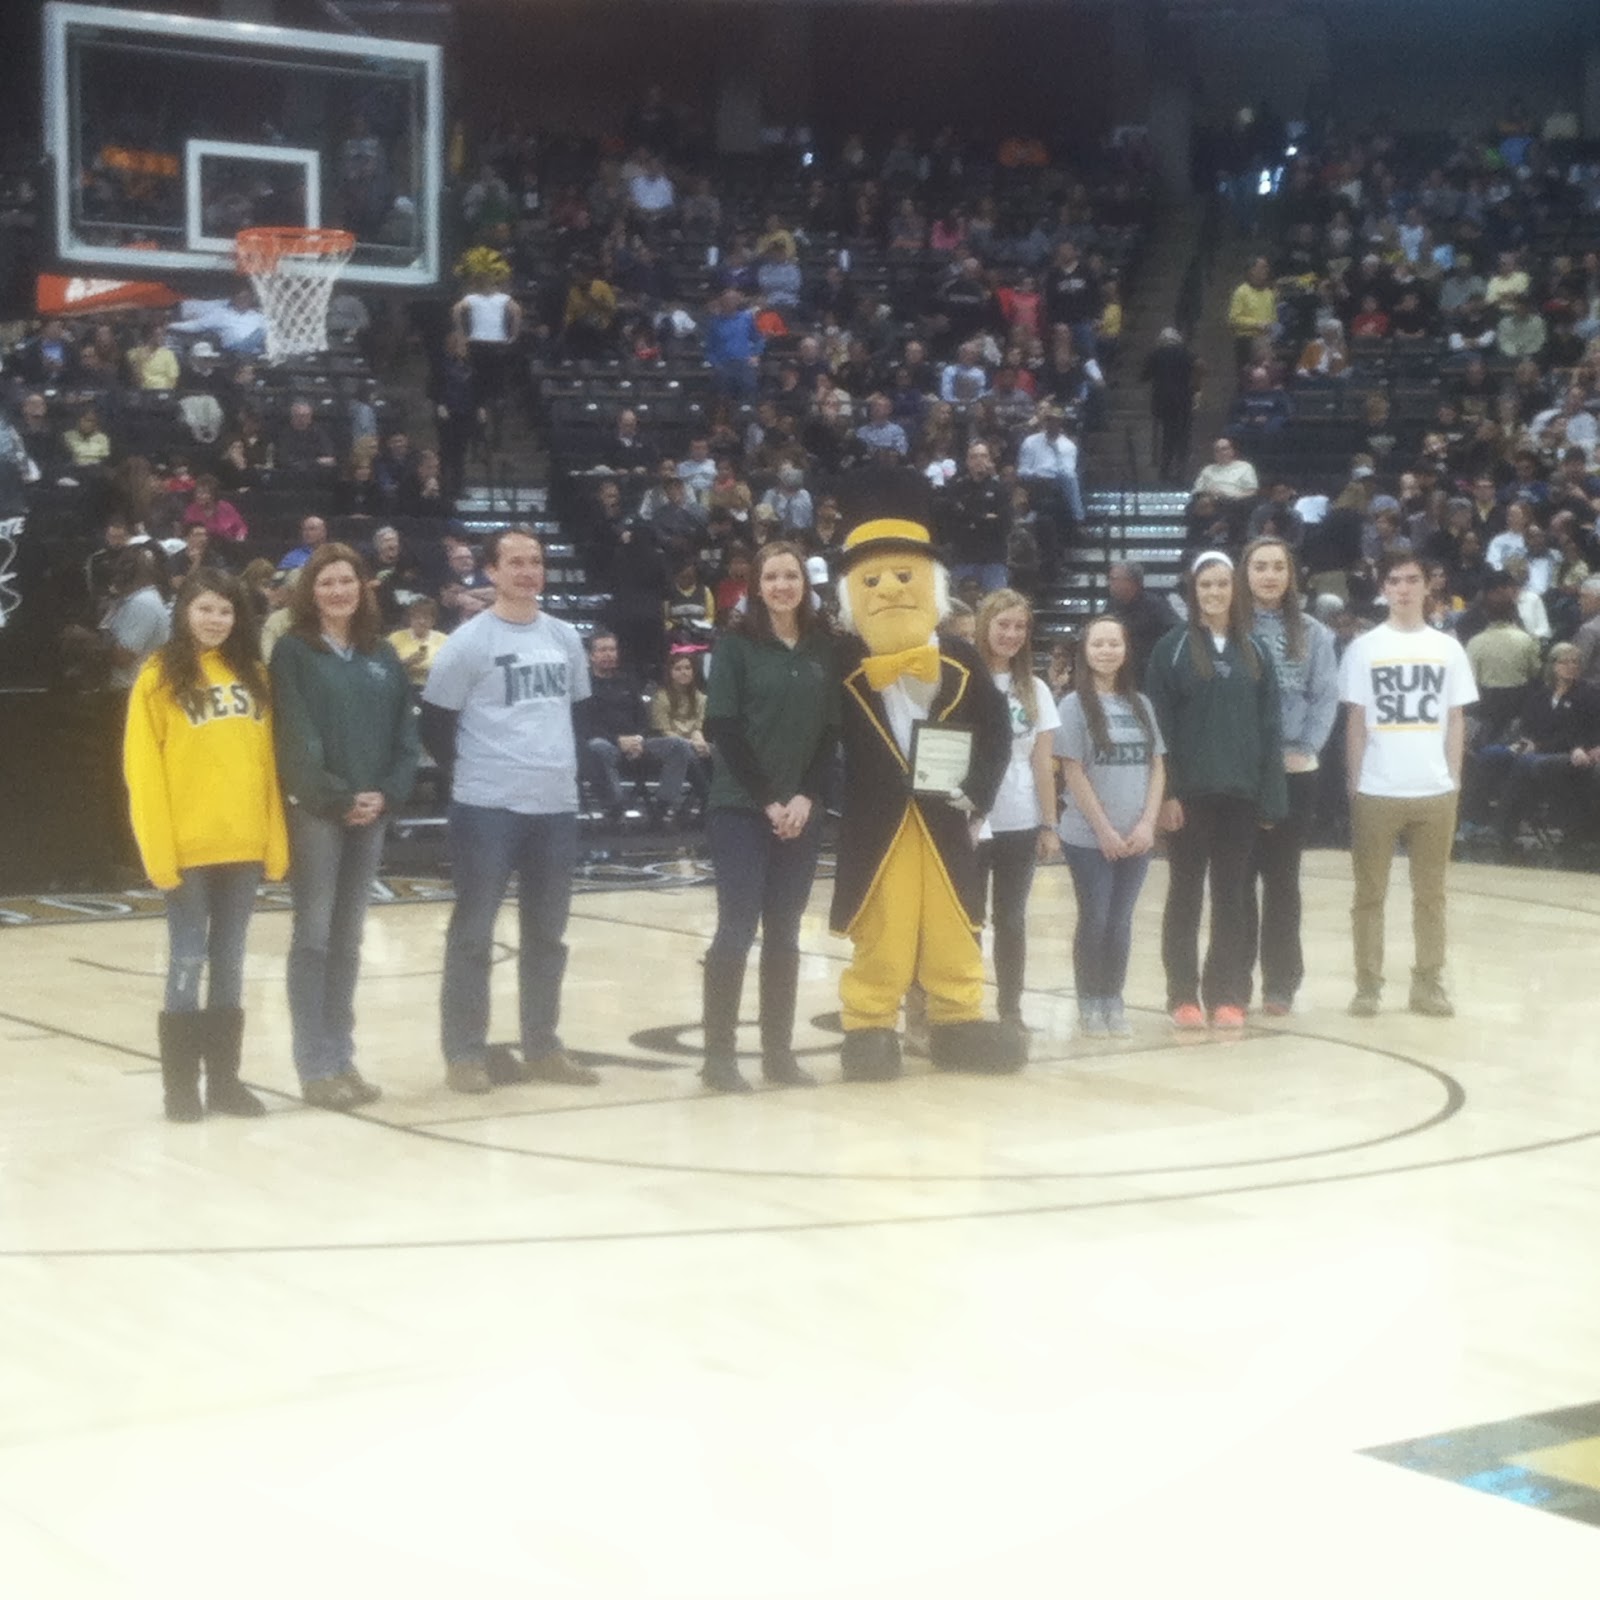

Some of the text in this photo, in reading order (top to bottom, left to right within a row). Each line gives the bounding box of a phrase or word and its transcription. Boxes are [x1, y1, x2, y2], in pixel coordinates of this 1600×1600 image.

[1371, 664, 1446, 695] RUN
[179, 682, 265, 726] WES
[1376, 693, 1439, 724] SLC
